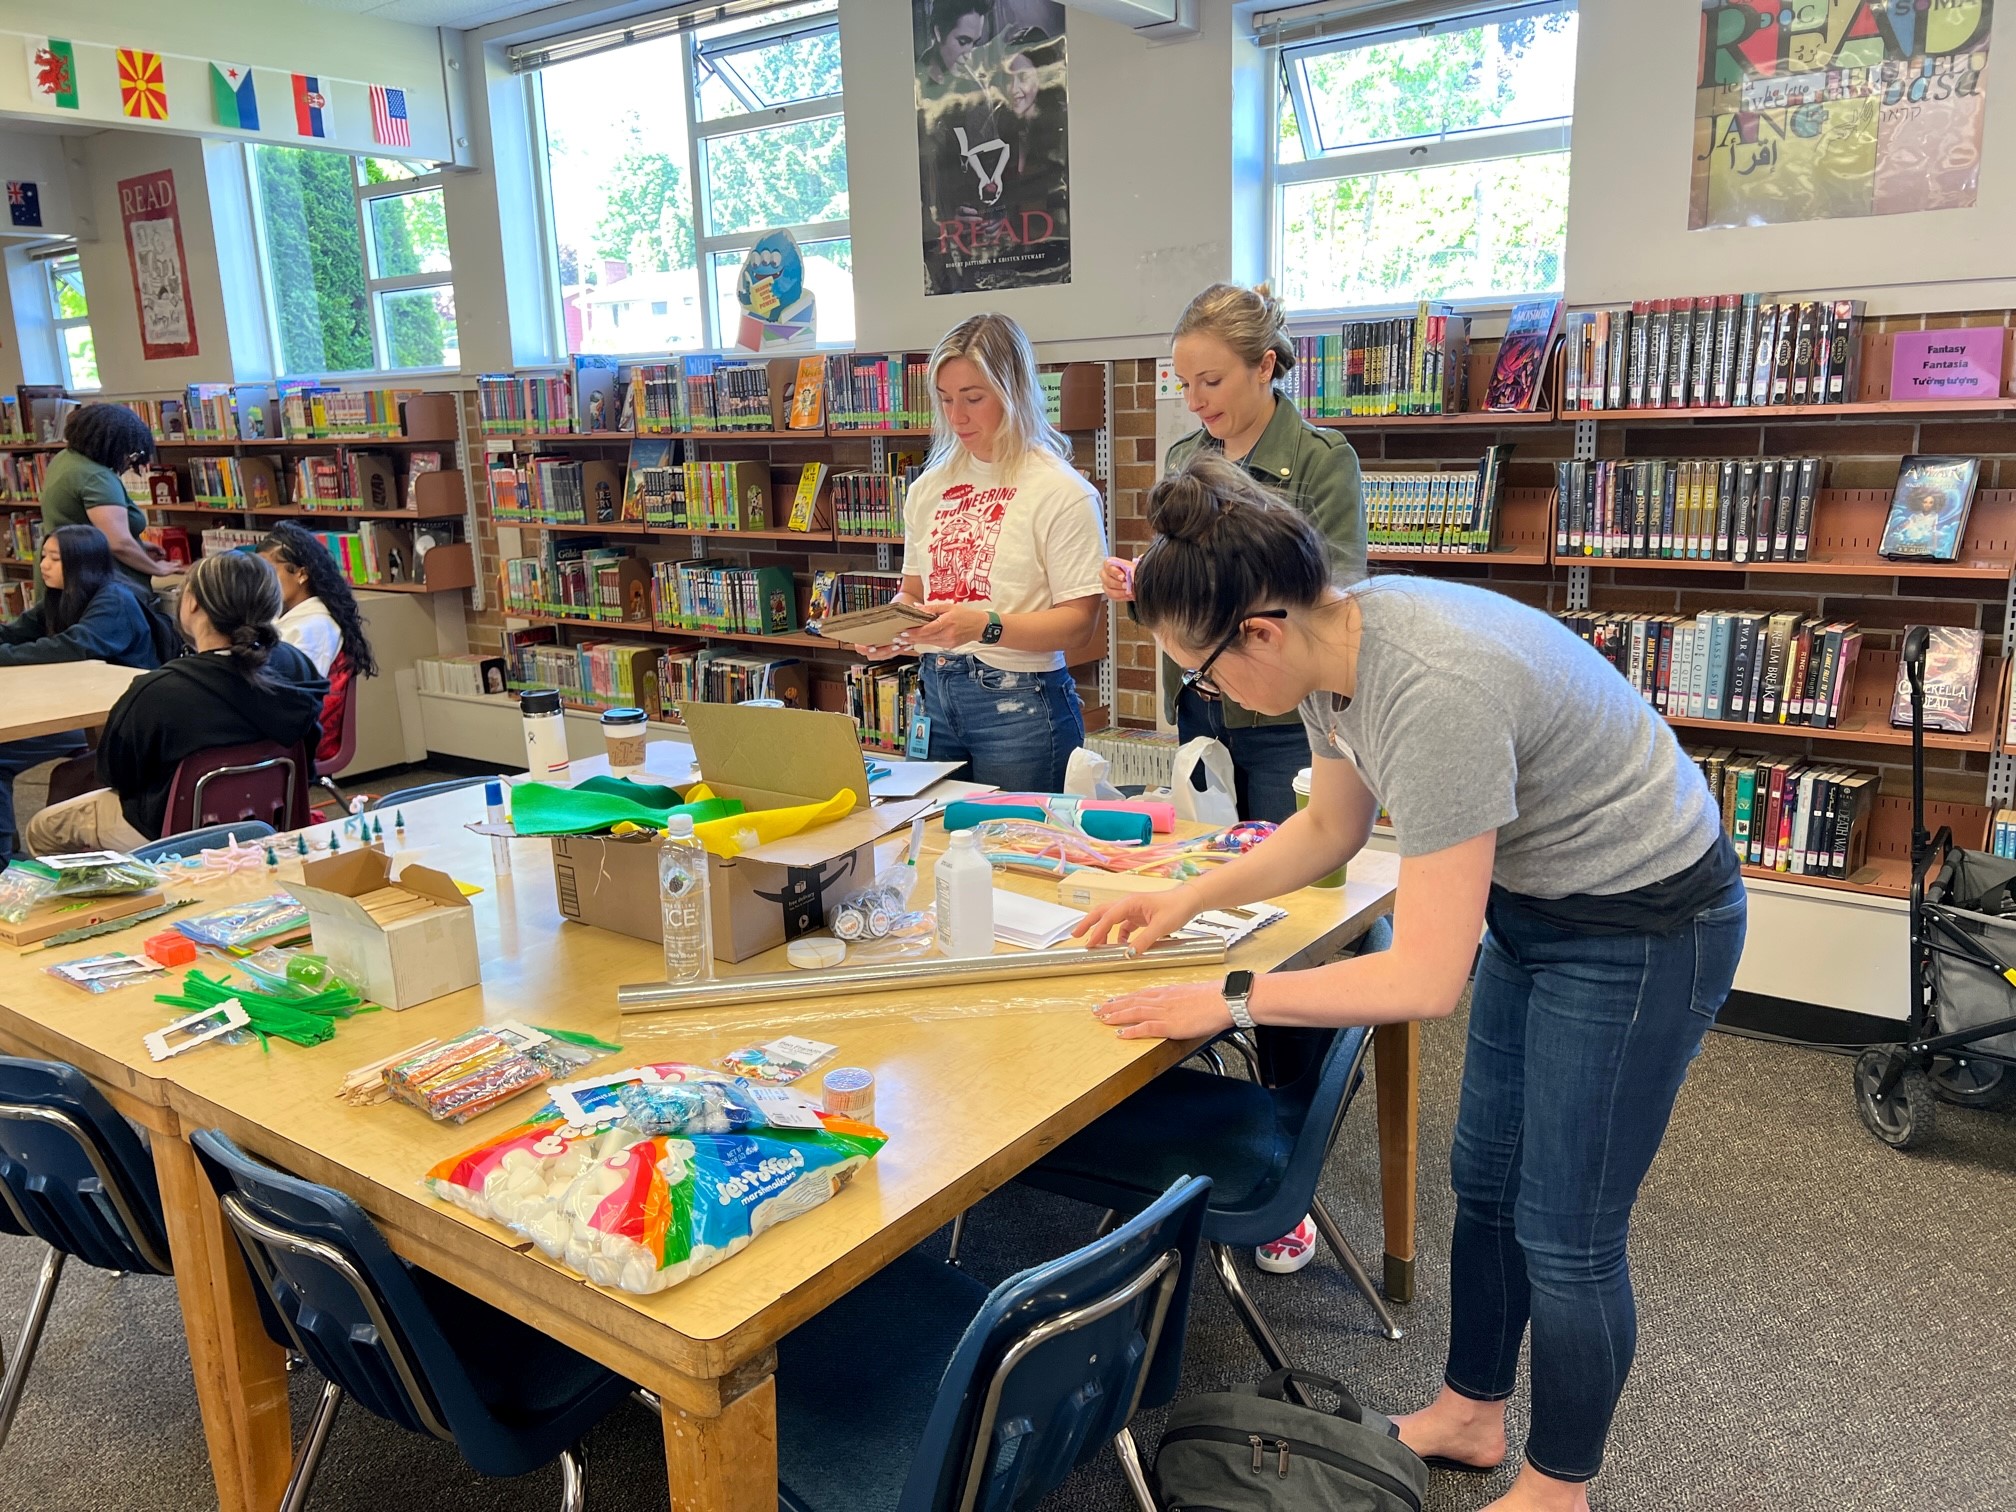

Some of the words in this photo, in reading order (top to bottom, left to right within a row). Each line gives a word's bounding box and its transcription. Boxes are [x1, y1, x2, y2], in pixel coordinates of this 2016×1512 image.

[122, 180, 173, 216] READ
[938, 210, 1054, 256] READ
[998, 255, 1020, 263] KRISTEN
[1021, 253, 1046, 261] STEWART
[169, 312, 180, 324] Kid
[1630, 326, 1640, 357] BLOOD
[1650, 325, 1660, 356] BLOOD
[1672, 323, 1682, 354] BLOOD
[1694, 322, 1705, 355] BLOOD
[1715, 321, 1727, 354] BLOOD
[1927, 345, 1966, 354] Fantasy
[688, 359, 719, 375] WHIT
[1922, 360, 1969, 369] Fantasia
[1633, 635, 1641, 651] ARLO
[1647, 637, 1656, 653] ARLO
[1661, 638, 1670, 653] ARLO
[1697, 629, 1706, 651] RED
[1714, 626, 1723, 660] GLASS
[1739, 626, 1750, 650] WAR
[1768, 629, 1783, 665] REALM
[1631, 652, 1639, 669] FINCH
[1673, 641, 1681, 660] RED
[1684, 641, 1692, 660] RED
[1799, 651, 1807, 671] RING
[1645, 653, 1655, 672] FINCH
[1671, 668, 1679, 688] QUE
[1681, 669, 1689, 689] QUE
[1693, 664, 1702, 689] QUE
[1710, 673, 1719, 696] SWO
[1734, 666, 1745, 694] STOR
[1762, 665, 1778, 700] BREAK
[1794, 680, 1803, 700] FIRE
[1898, 679, 1968, 701] CIERELLA
[1836, 808, 1850, 836] DEATH
[665, 908, 696, 927] ICE
[726, 1149, 738, 1159] NET
[716, 1148, 804, 1206] Jet-Puffed
[741, 1171, 796, 1206] marshmallows
